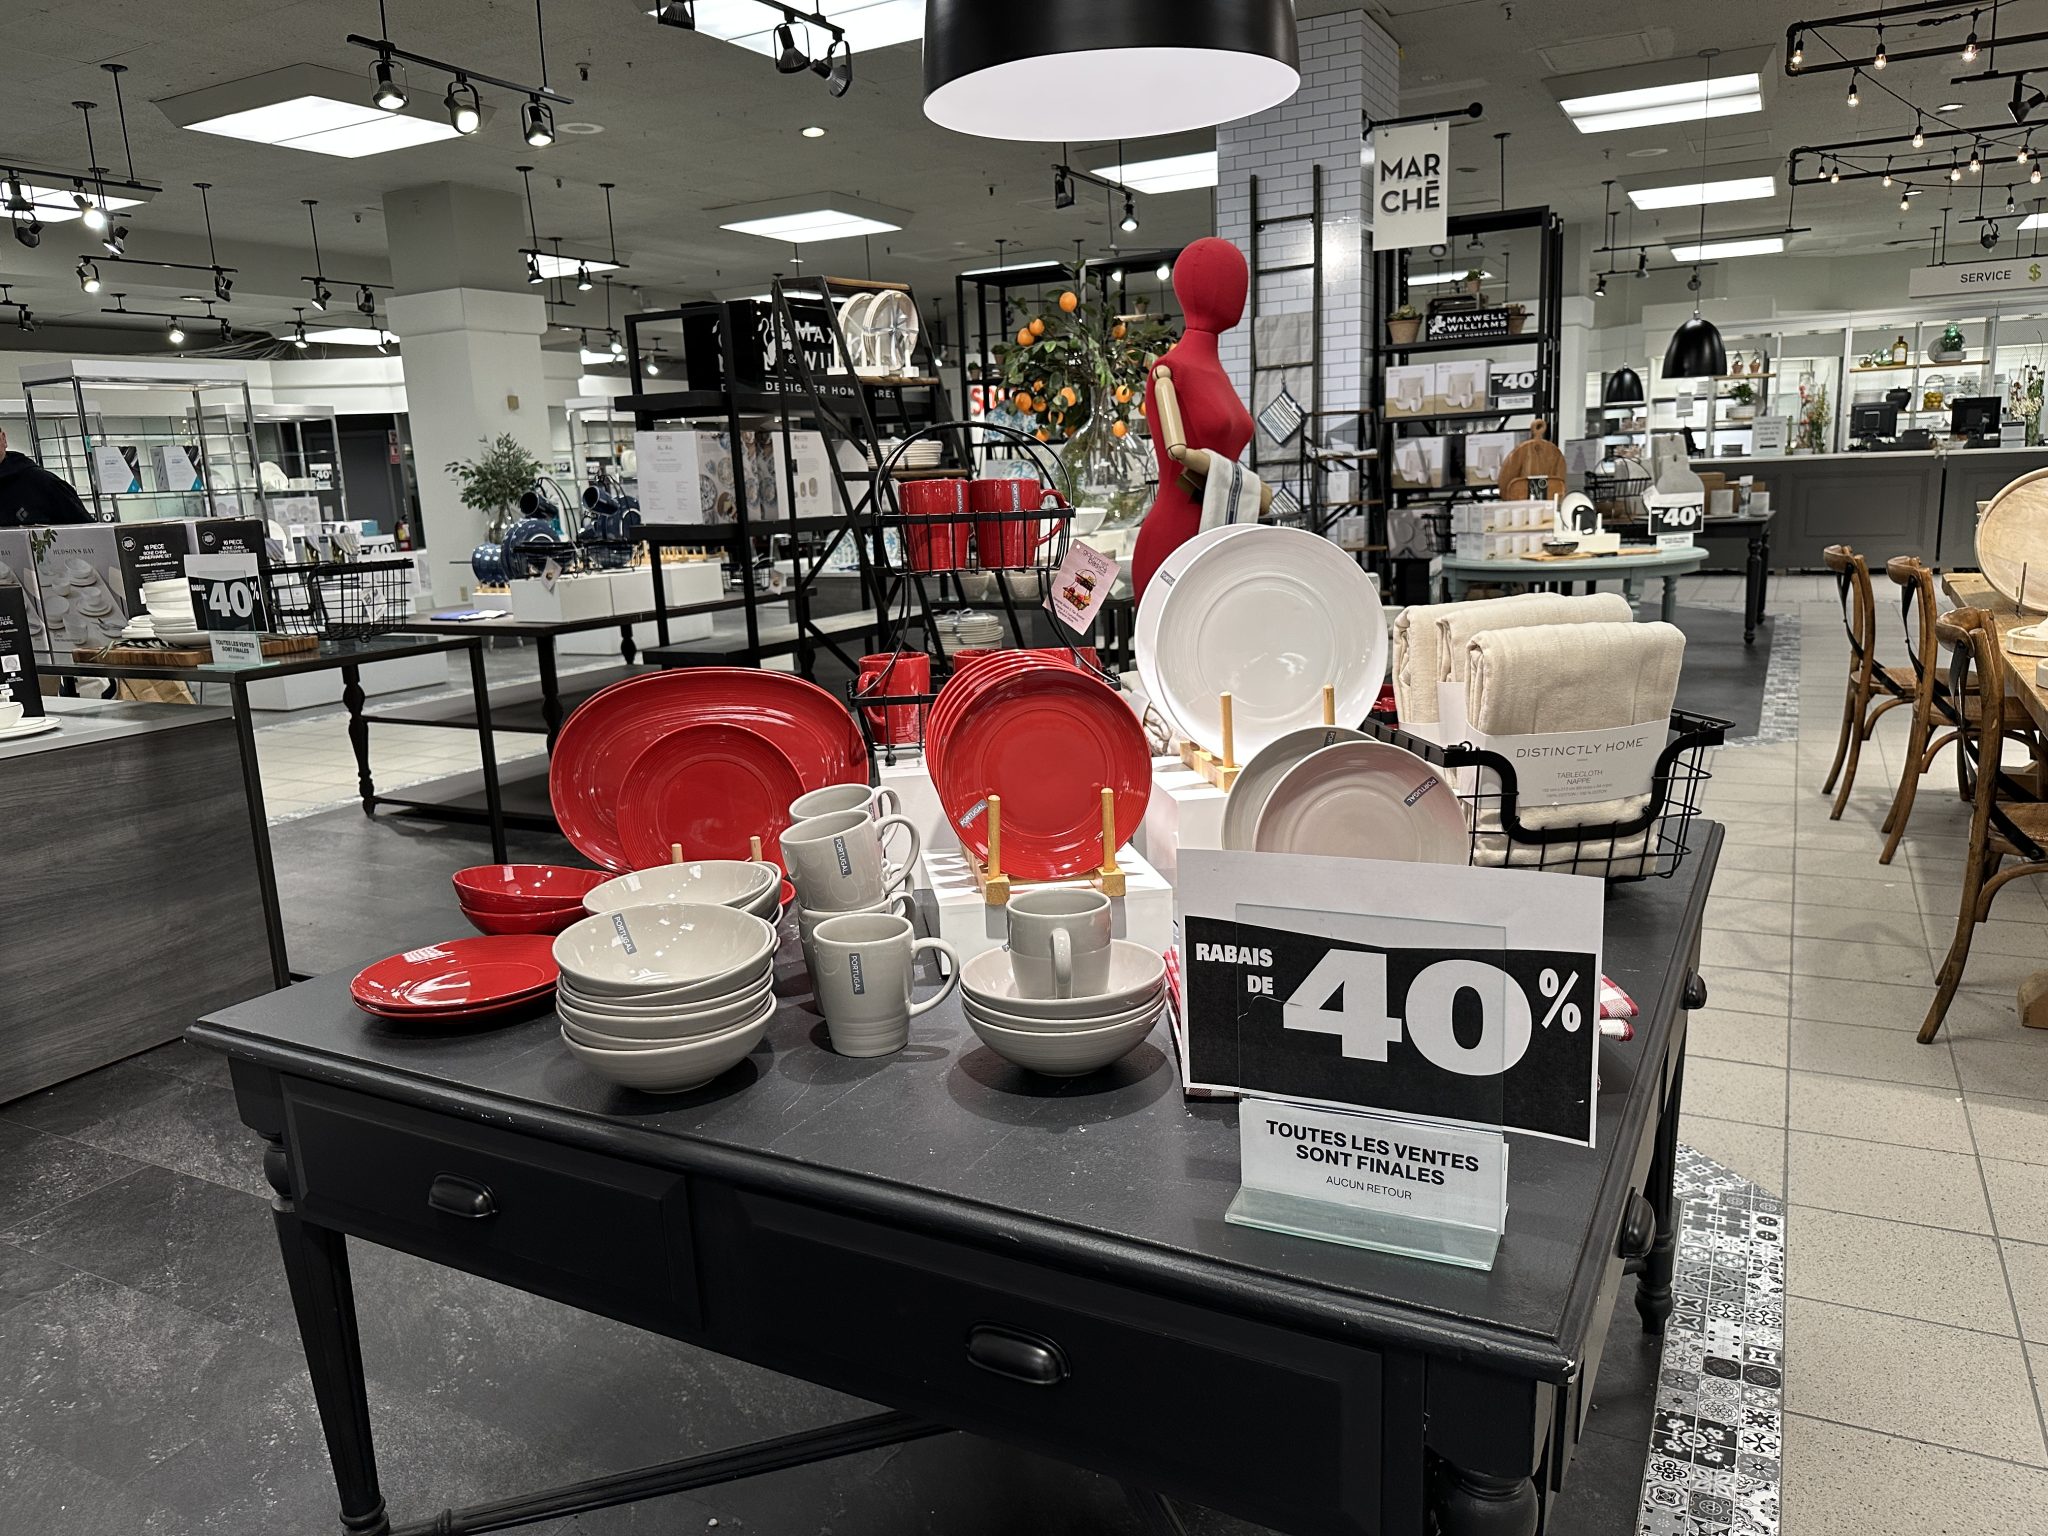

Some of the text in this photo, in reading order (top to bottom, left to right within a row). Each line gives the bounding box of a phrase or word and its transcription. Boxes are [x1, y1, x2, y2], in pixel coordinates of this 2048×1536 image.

[1381, 153, 1440, 181] MAR
[1960, 270, 2012, 284] SERVICE
[1446, 313, 1505, 324] MAXWELL
[1446, 320, 1508, 332] WILLIAMS
[1516, 738, 1644, 758] DISTINCTLY HOME
[1557, 769, 1603, 779] TABLECLOTH
[1407, 780, 1437, 803] PORTUGAL
[835, 838, 849, 874] PORTUGAL
[614, 916, 633, 953] PORTUGAL
[1196, 943, 1273, 968] RABAIS
[851, 955, 861, 993] PORTUGAL
[1247, 974, 1274, 995] DE
[1266, 1119, 1479, 1172] TOUTES LES VENTES
[1296, 1145, 1445, 1186] SONT FINALES
[1326, 1175, 1412, 1200] AUCUN RETOUR
